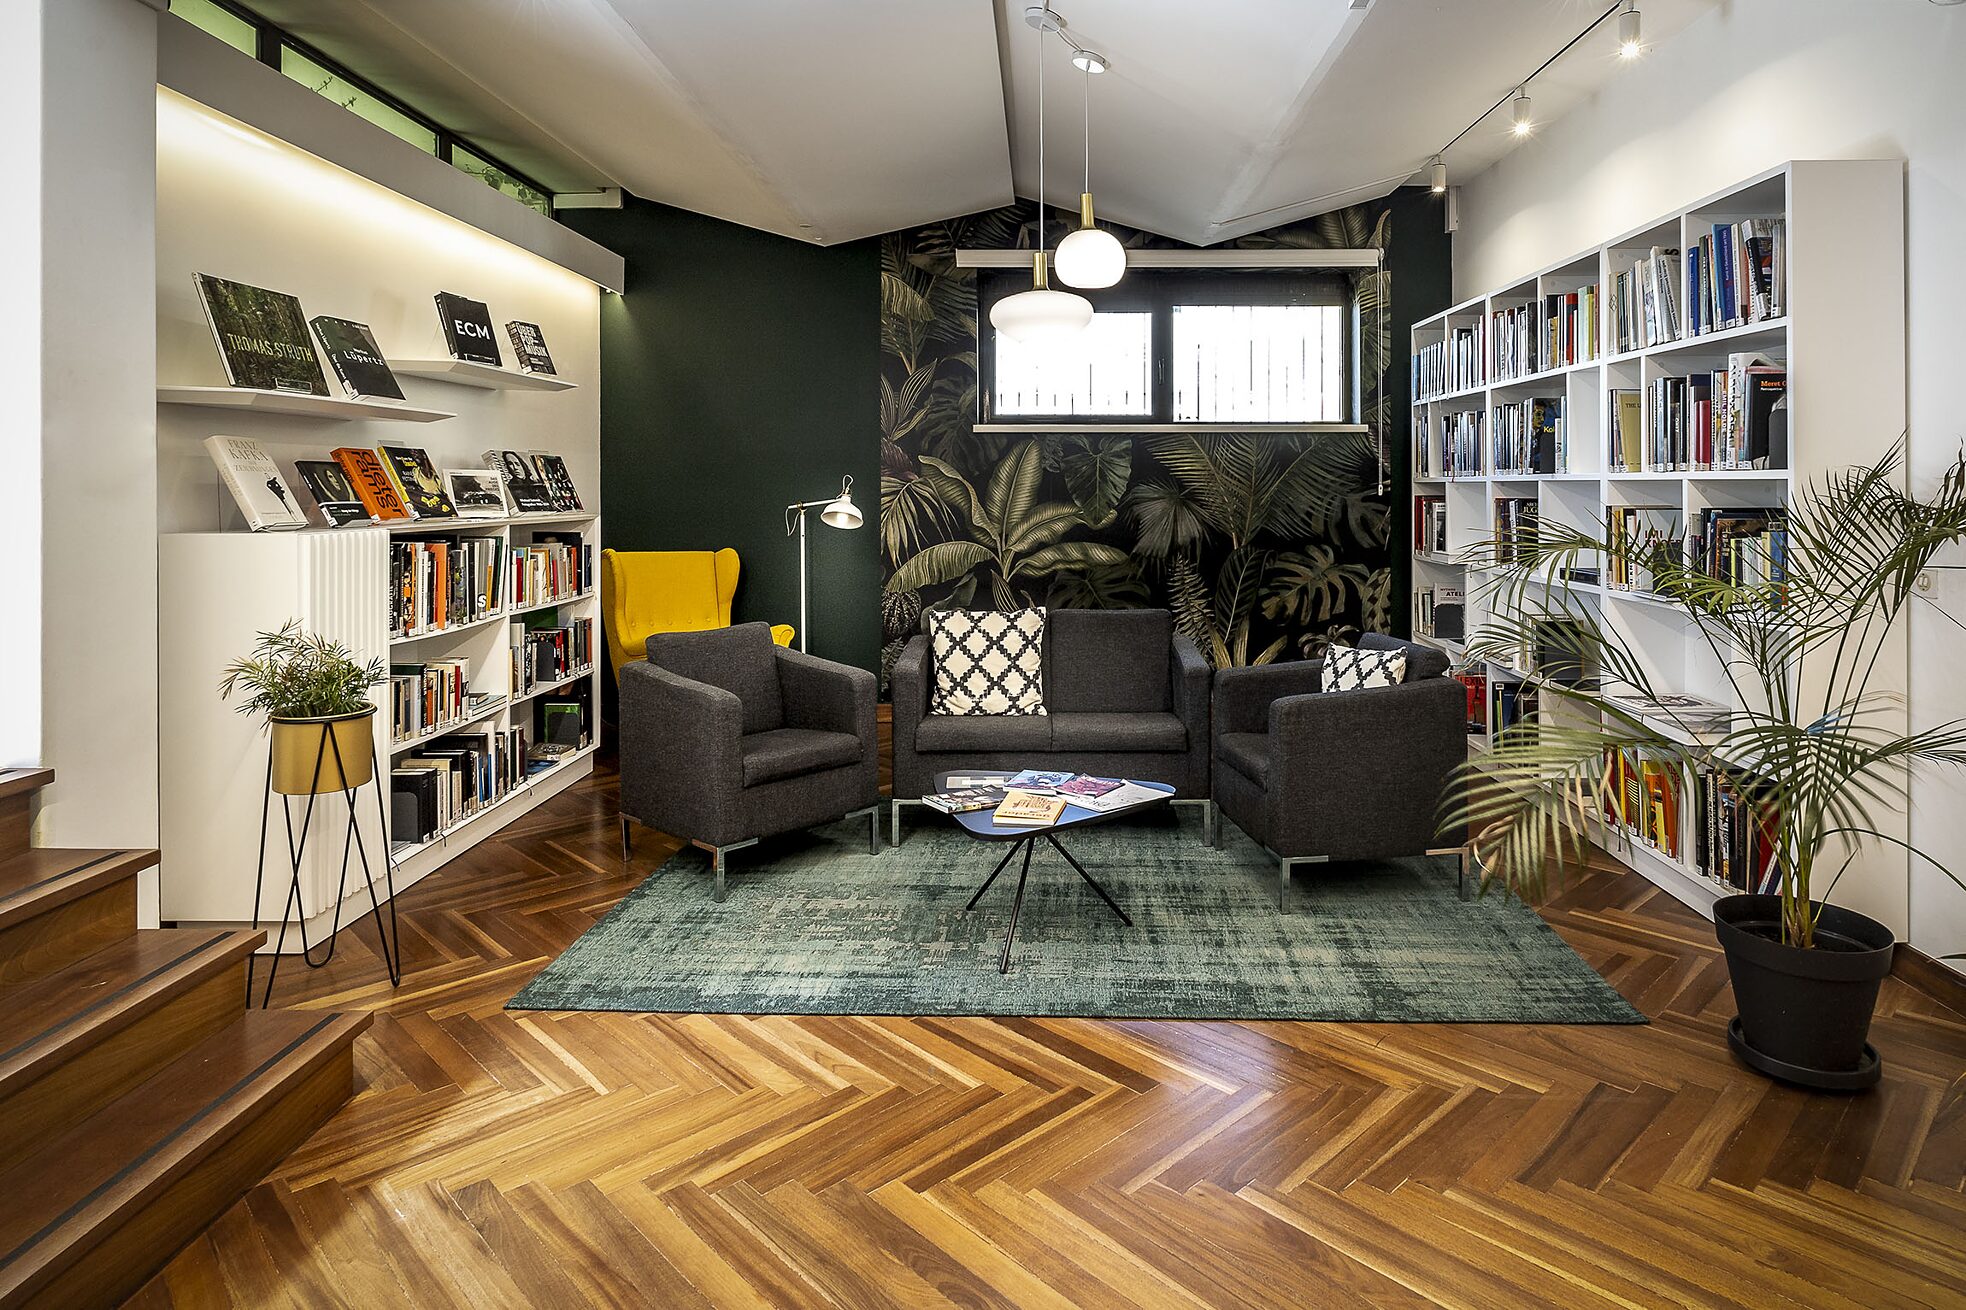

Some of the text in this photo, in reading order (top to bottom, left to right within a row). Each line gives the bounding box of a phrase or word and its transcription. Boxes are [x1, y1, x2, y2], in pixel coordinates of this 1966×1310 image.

[454, 319, 490, 340] ECM
[227, 333, 313, 362] THOMAS STRUTH
[343, 350, 384, 366] Lüpertz
[228, 439, 256, 450] FRANZ
[228, 448, 269, 461] KAFKA
[351, 450, 386, 509] rams
[361, 451, 405, 517] dieter
